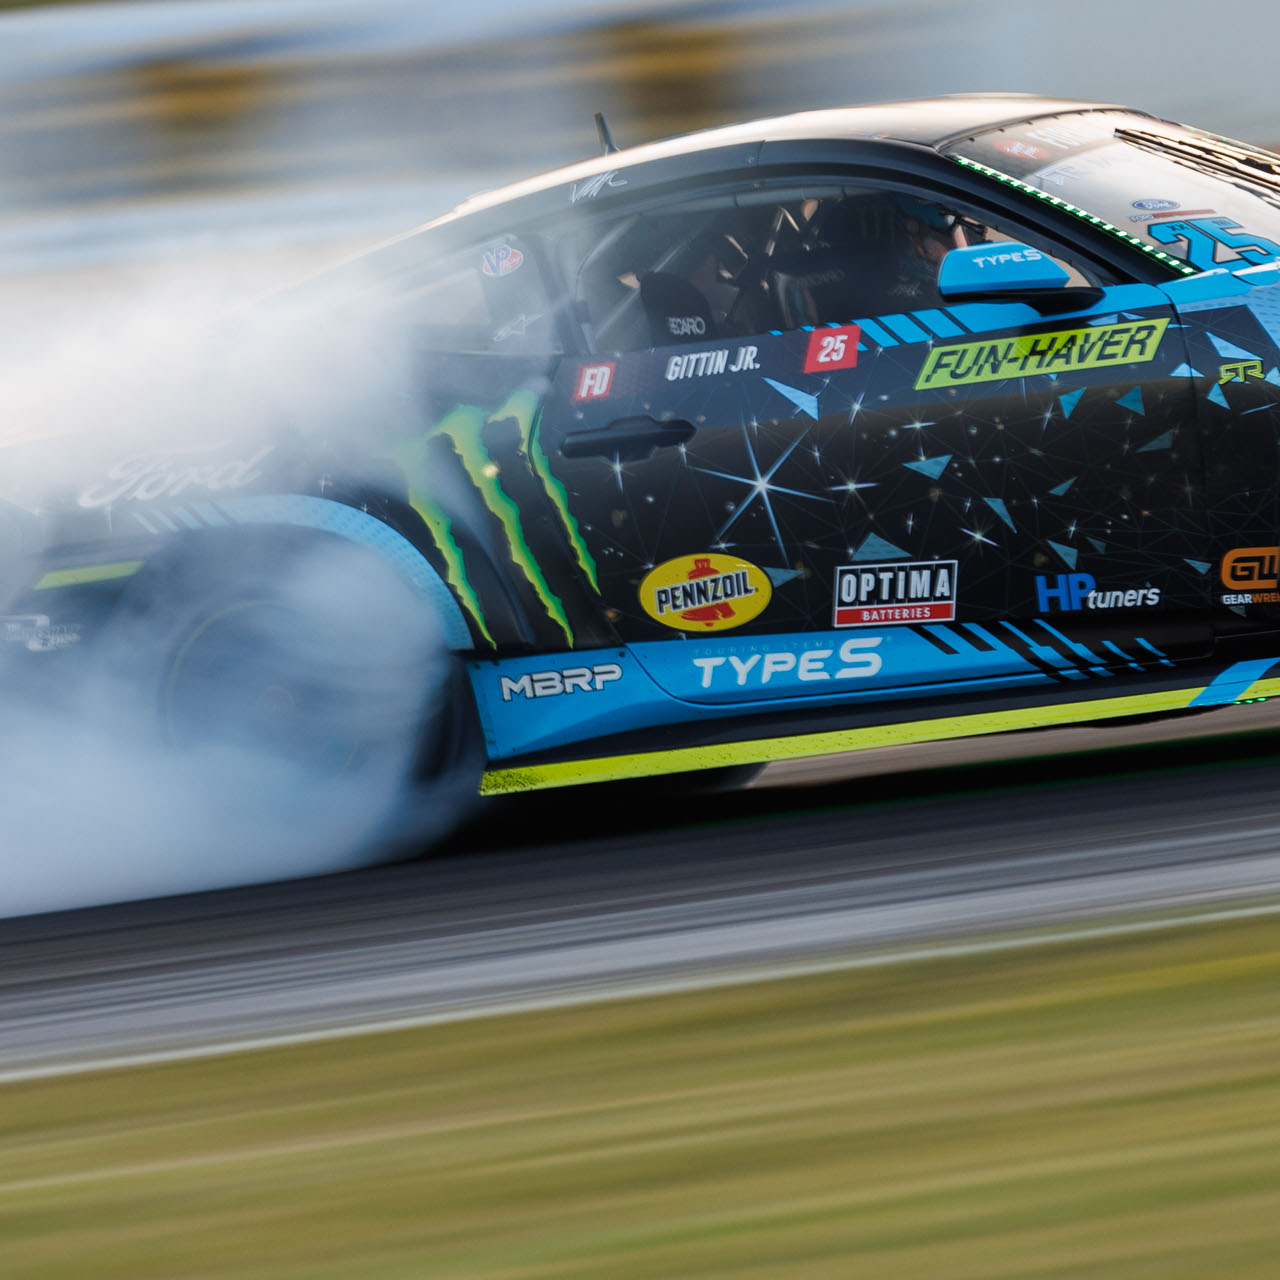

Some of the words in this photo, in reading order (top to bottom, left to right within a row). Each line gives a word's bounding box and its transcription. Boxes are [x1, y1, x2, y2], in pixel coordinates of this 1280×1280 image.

[483, 244, 513, 274] VP
[665, 350, 729, 381] GITTIN
[729, 345, 761, 372] JR.
[817, 333, 848, 363] 25
[924, 324, 1158, 384] FUN-HAVER
[579, 365, 612, 399] FD
[1218, 360, 1266, 386] RTR
[77, 445, 275, 509] Ford
[655, 569, 754, 616] PENNZOIL
[840, 568, 952, 604] OPTIMA
[861, 606, 932, 622] BATTERIES
[500, 663, 623, 701] MBRP
